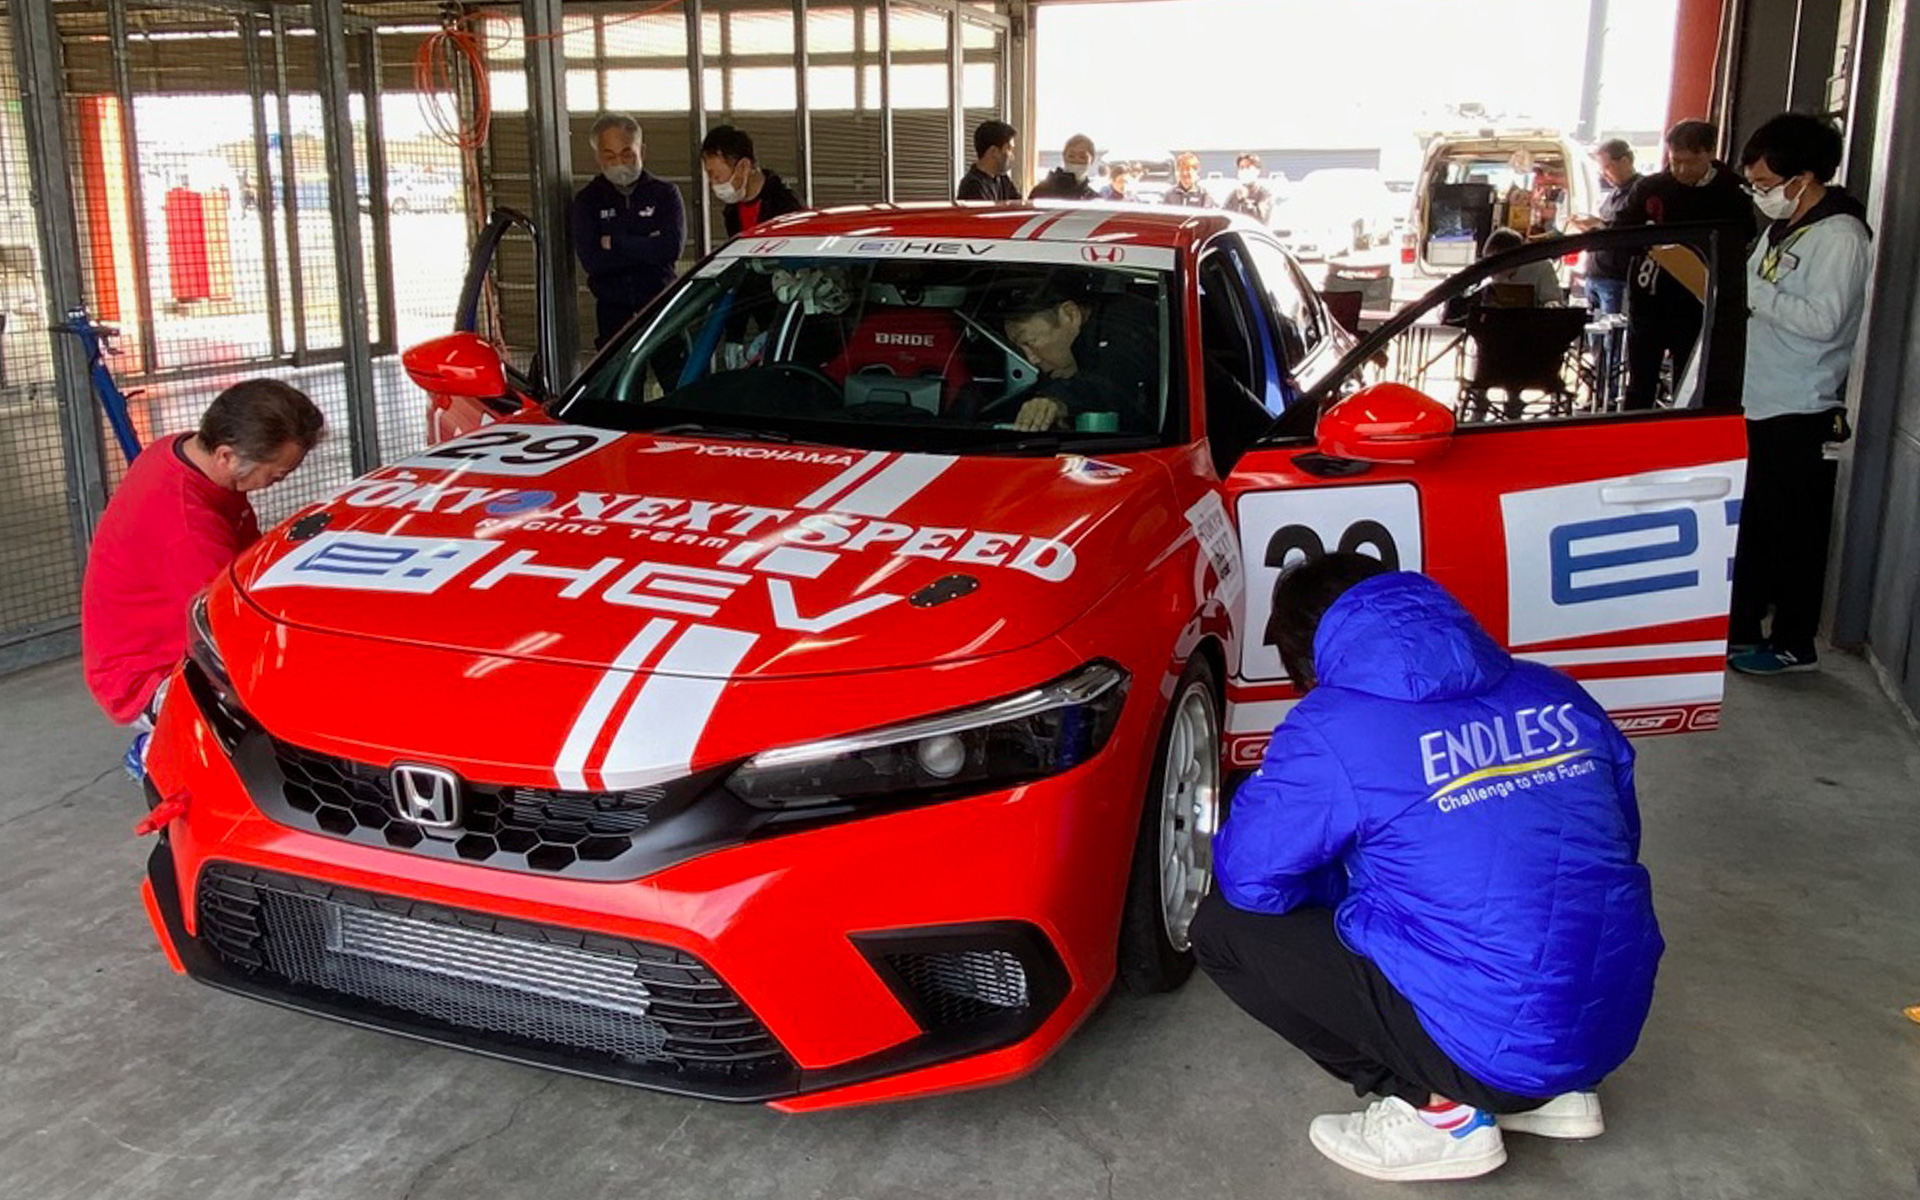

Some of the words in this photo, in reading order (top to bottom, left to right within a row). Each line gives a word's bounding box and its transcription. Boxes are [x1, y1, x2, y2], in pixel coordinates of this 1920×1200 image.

[875, 332, 934, 347] BRIDE
[422, 430, 599, 465] 29
[695, 444, 852, 466] YOKOHAMA
[551, 491, 794, 537] NEXT
[782, 513, 1077, 582] SPEED
[1419, 703, 1579, 785] ENDLESS
[1438, 780, 1515, 812] Challenge
[1515, 776, 1531, 789] to
[1532, 769, 1556, 785] the
